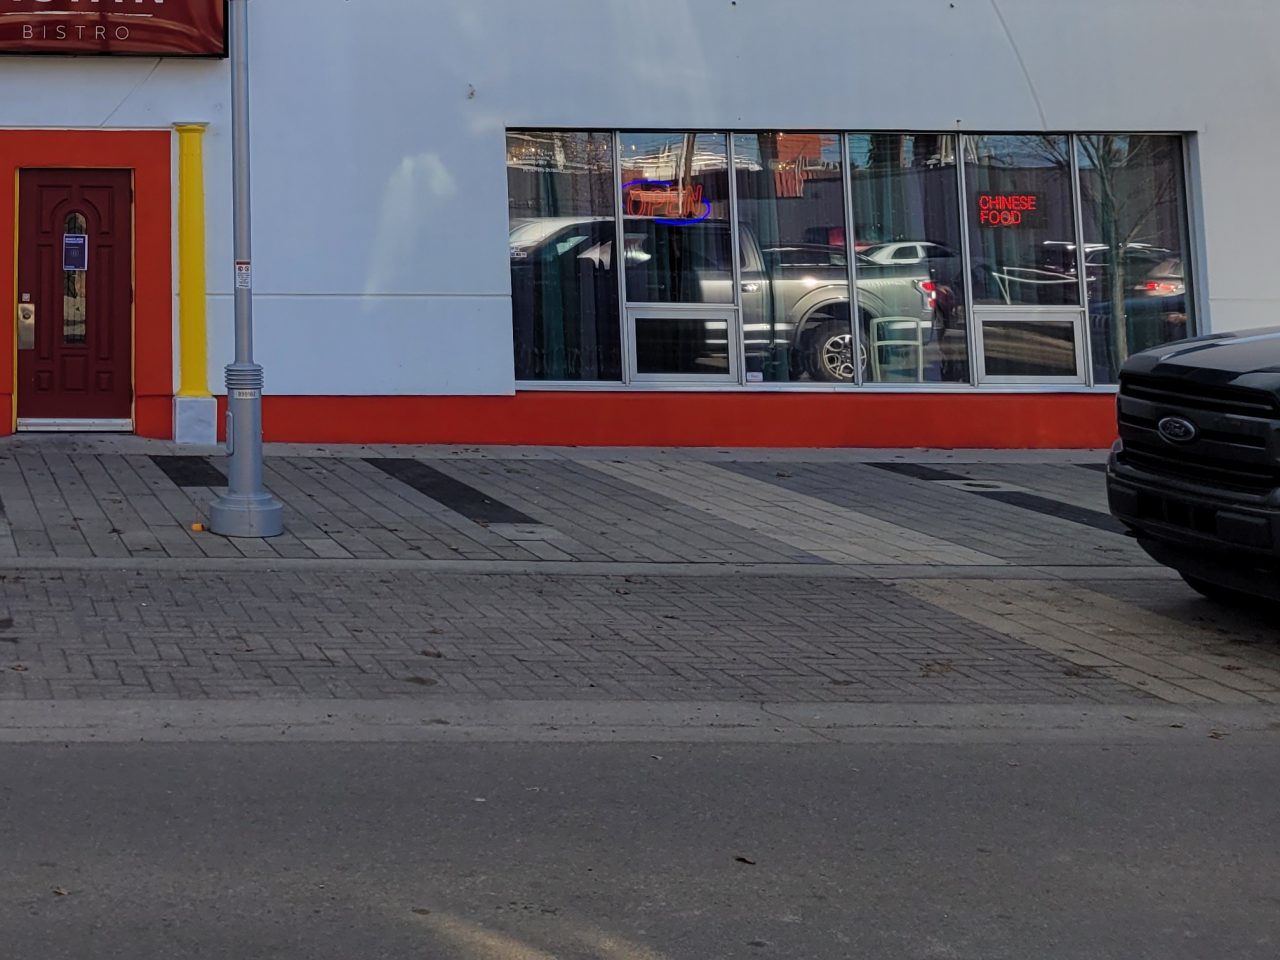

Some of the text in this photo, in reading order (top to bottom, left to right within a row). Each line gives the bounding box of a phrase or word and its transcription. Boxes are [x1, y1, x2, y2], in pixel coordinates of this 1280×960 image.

[22, 24, 130, 40] BISTRO
[627, 185, 703, 217] OPEN
[979, 195, 1037, 210] CHINESE
[980, 210, 1022, 225] FOOD
